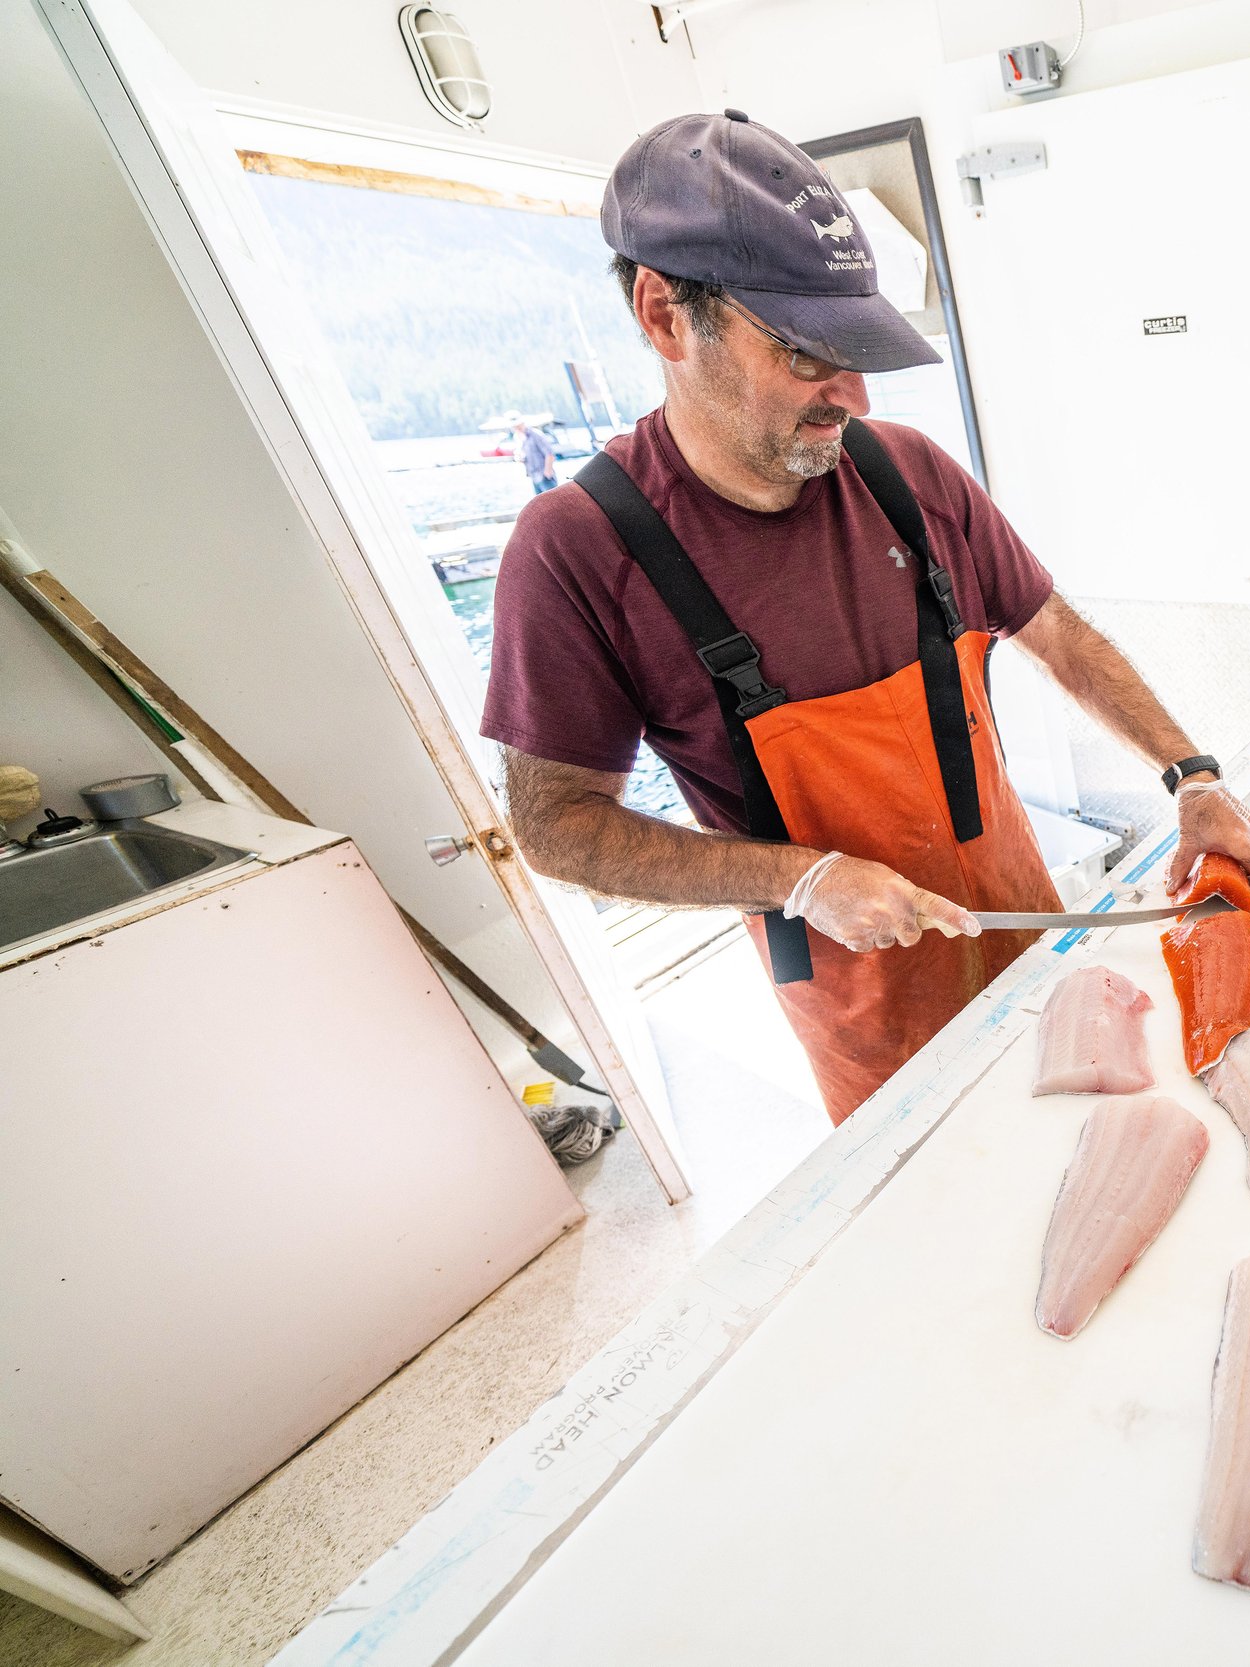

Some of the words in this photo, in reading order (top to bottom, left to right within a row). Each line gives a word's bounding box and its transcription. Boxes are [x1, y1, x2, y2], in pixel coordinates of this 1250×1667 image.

[785, 190, 809, 213] PORT
[832, 250, 852, 260] West
[825, 260, 862, 271] Vancouver
[1145, 317, 1185, 329] curtis
[529, 1384, 606, 1456] PROGRAM
[535, 1410, 599, 1471] HEAD
